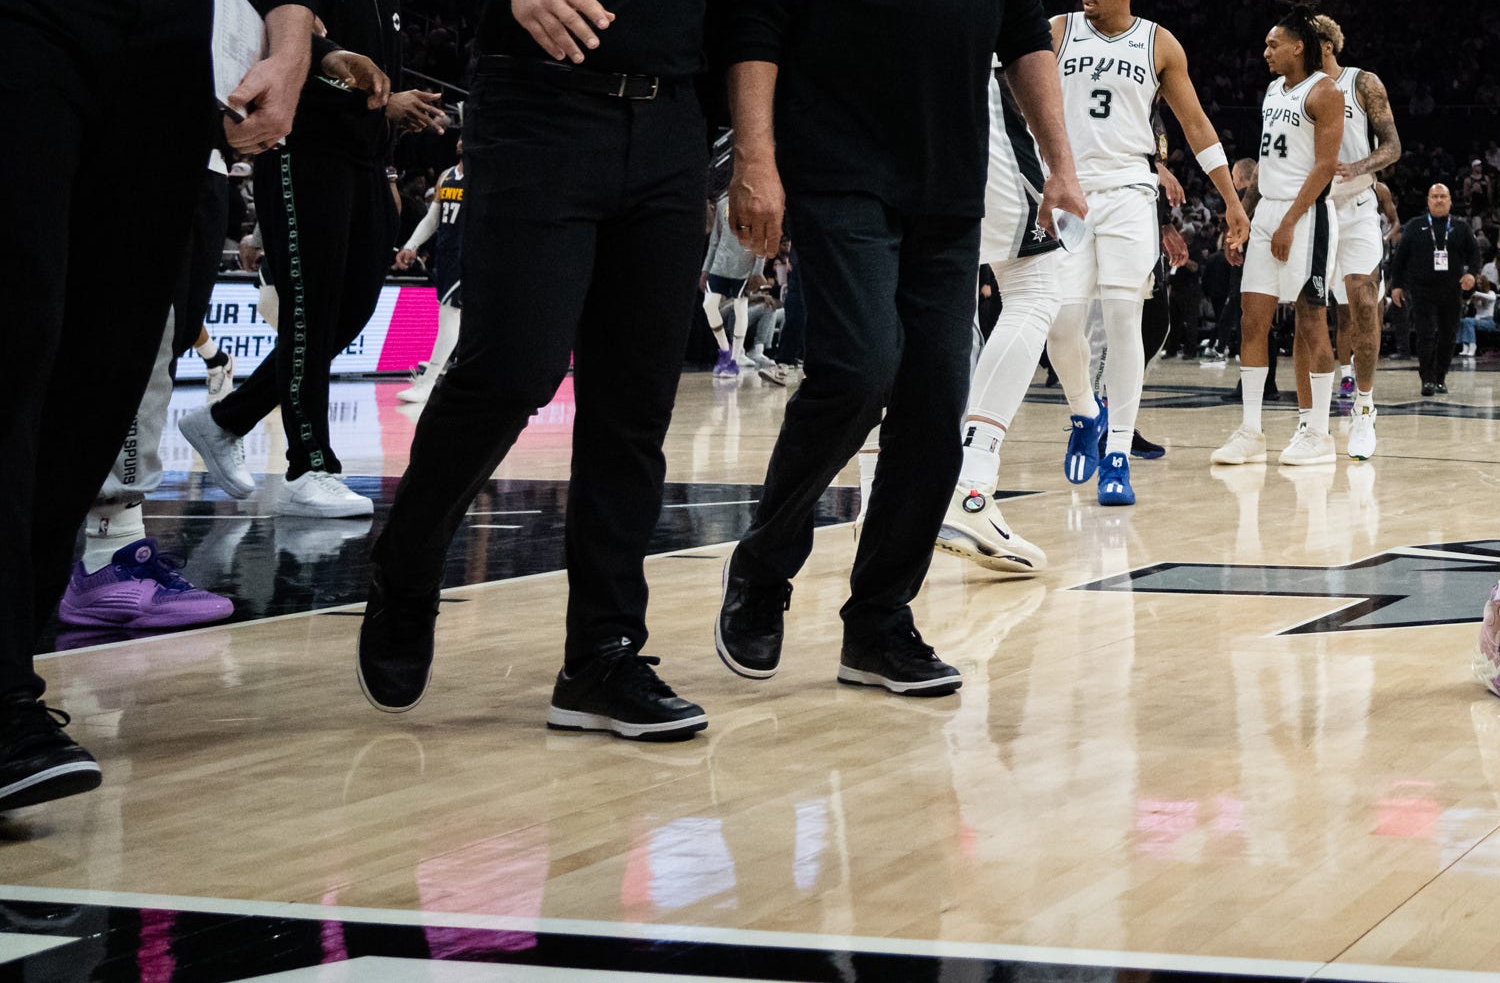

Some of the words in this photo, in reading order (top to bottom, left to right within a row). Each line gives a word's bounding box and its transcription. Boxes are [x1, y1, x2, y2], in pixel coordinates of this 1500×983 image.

[1128, 40, 1146, 50] Self.
[1064, 56, 1146, 85] SPURS
[1089, 89, 1112, 119] 3
[1260, 133, 1288, 158] 24
[442, 202, 461, 224] 27
[123, 439, 137, 485] SPURS
